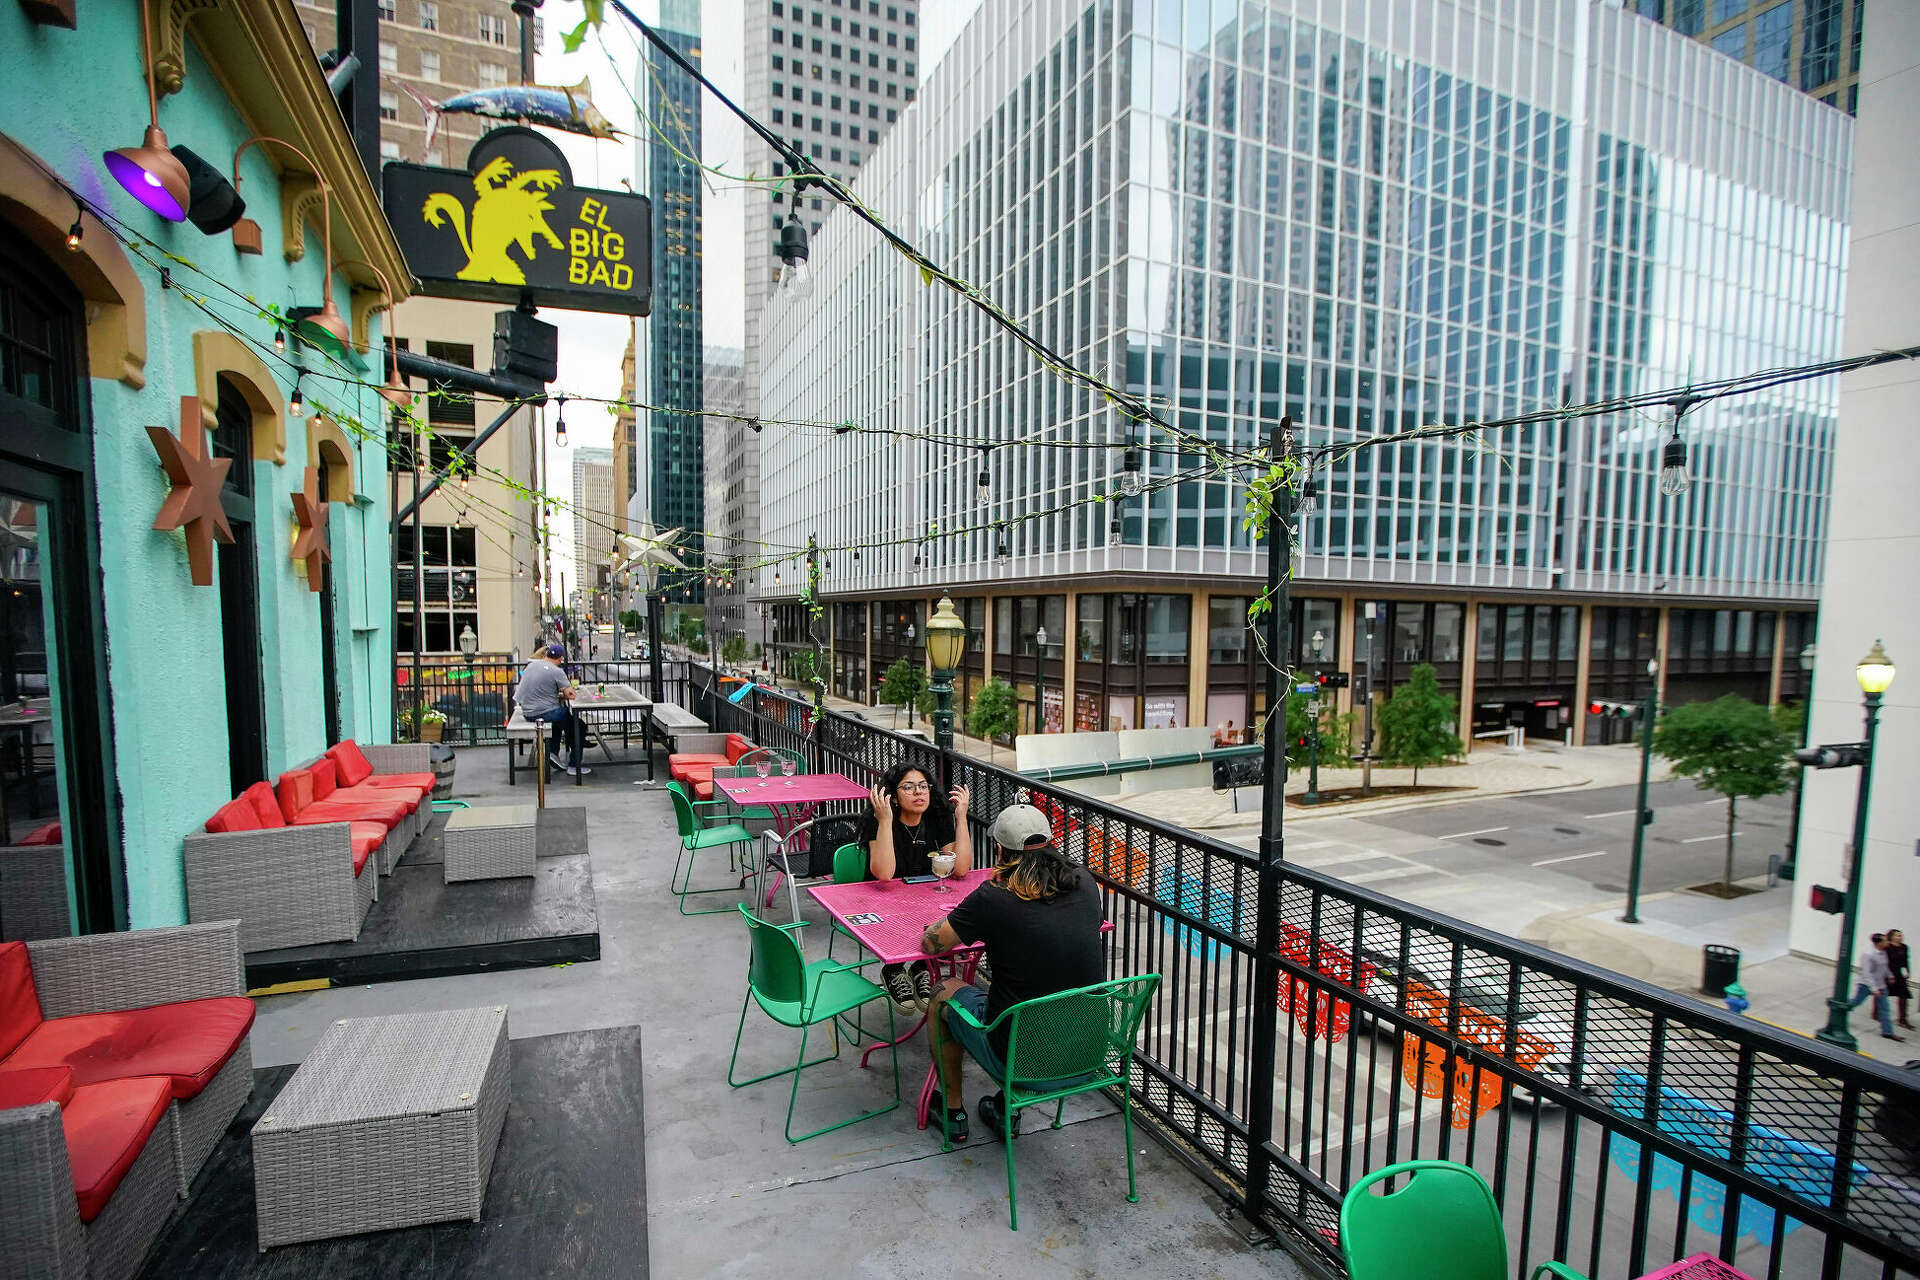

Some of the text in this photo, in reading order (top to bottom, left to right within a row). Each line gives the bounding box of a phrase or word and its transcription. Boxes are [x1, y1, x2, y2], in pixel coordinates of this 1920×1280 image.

[579, 197, 612, 232] EL
[569, 227, 625, 261] BIG
[568, 256, 634, 291] BAD
